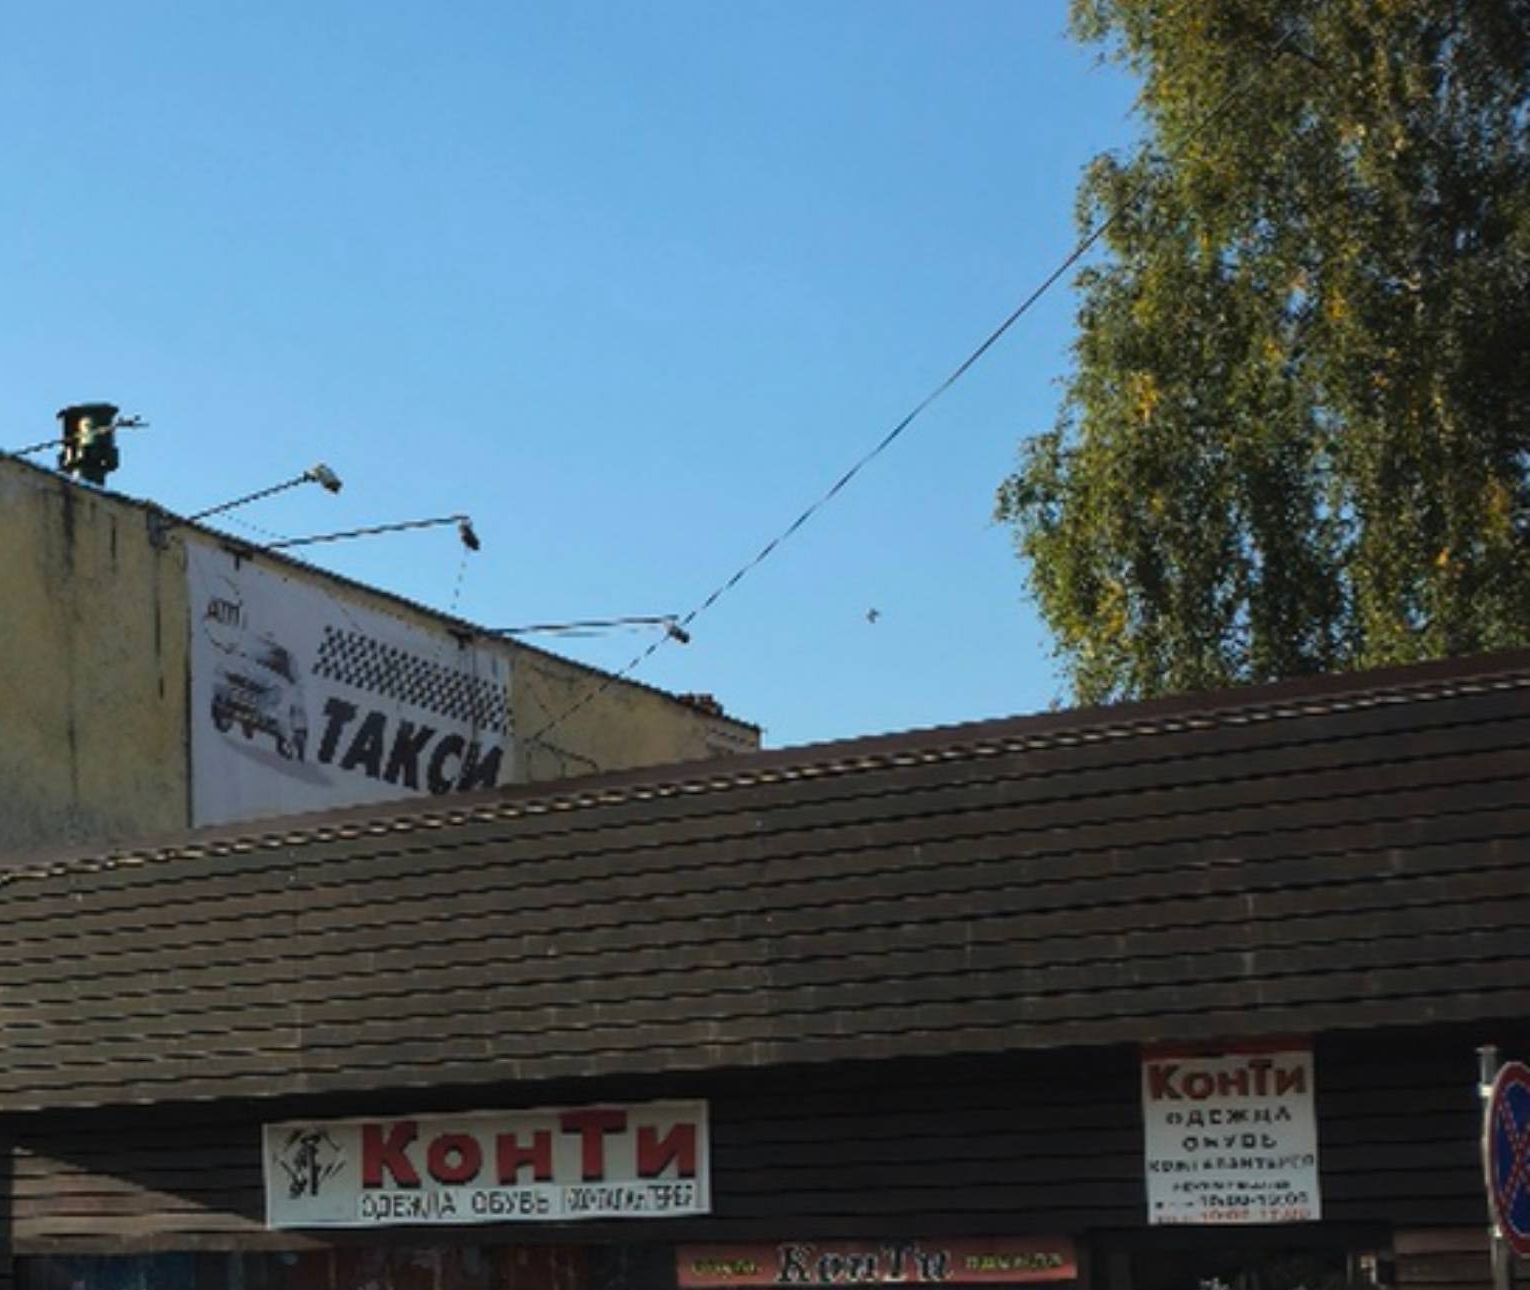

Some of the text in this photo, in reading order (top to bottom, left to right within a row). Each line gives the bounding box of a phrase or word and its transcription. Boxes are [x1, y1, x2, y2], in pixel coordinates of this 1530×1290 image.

[317, 697, 505, 796] ТАКСИ
[1164, 1105, 1293, 1128] ОДЕЖДА
[1181, 1132, 1278, 1153] ОБУВЬ
[360, 1191, 458, 1222] ОДЕЖДА
[470, 1190, 550, 1216] ОБУВЬ
